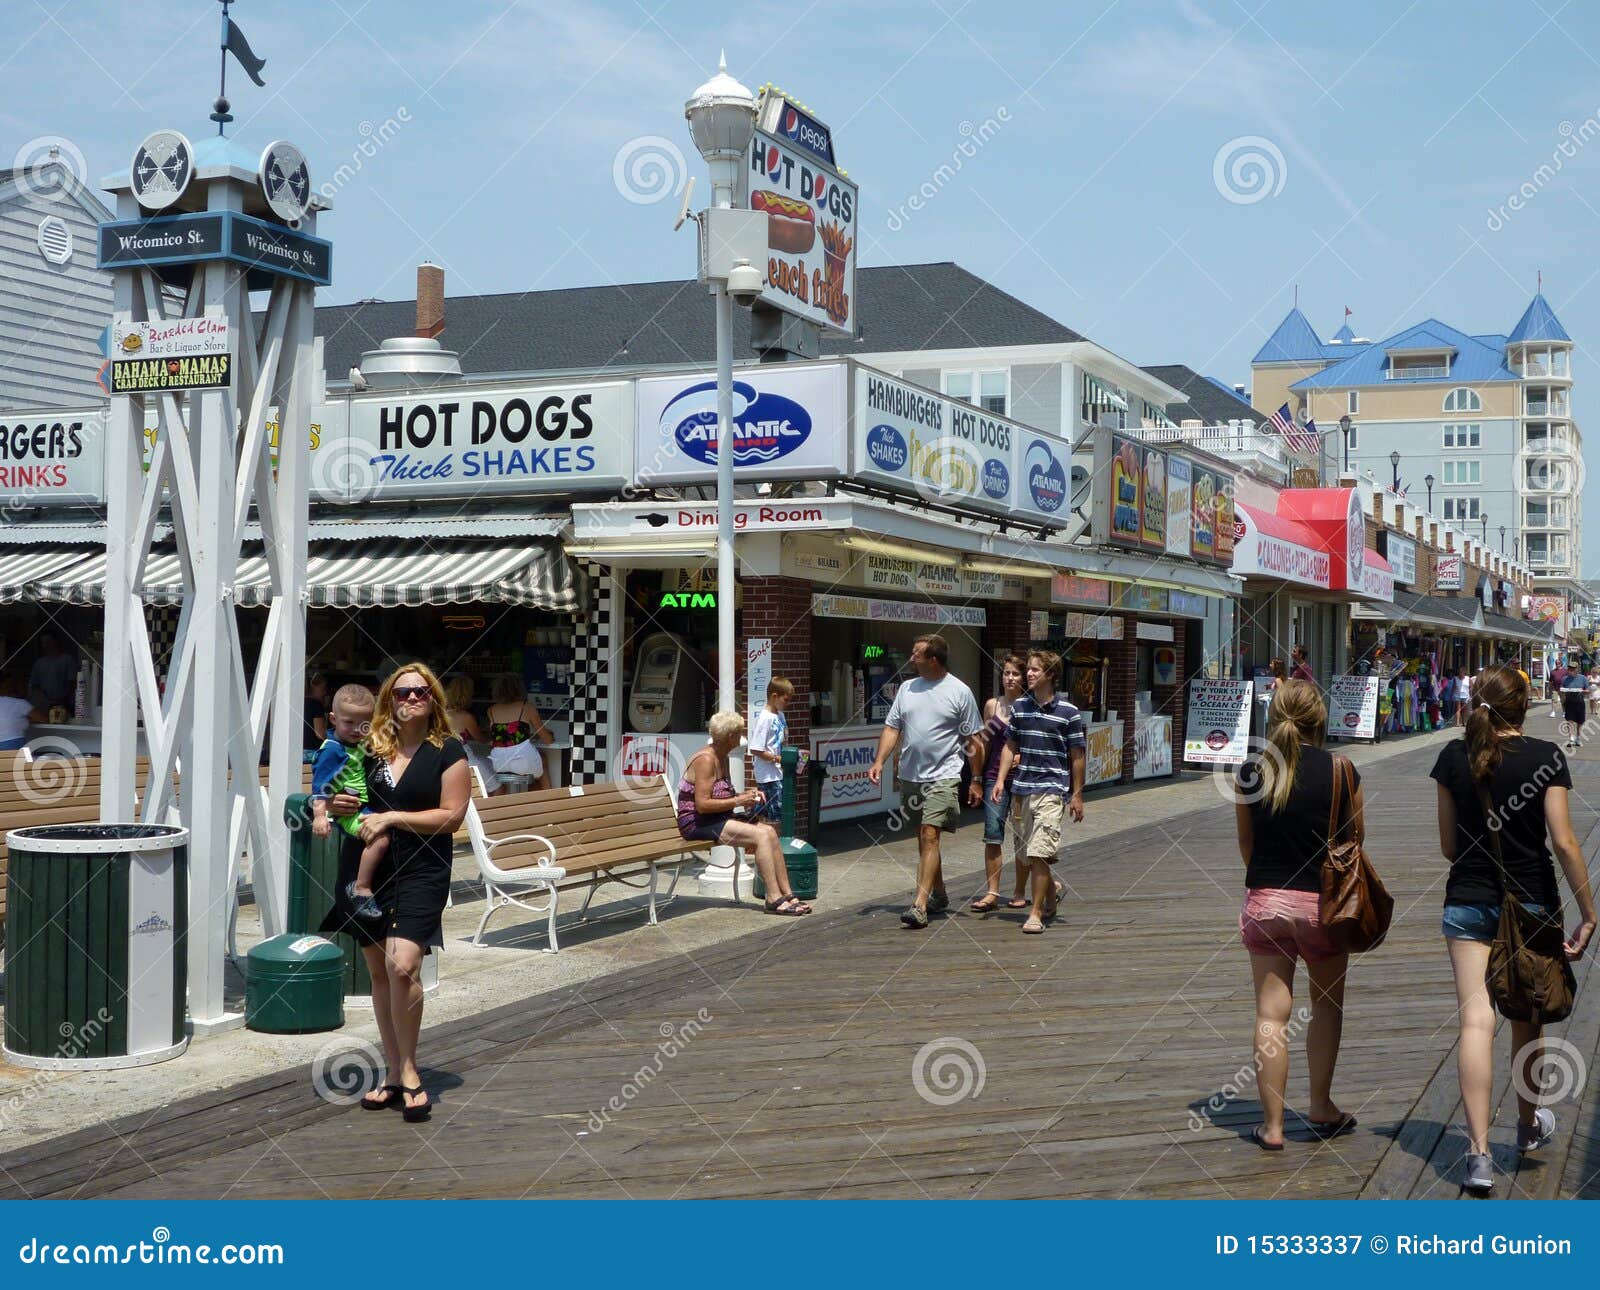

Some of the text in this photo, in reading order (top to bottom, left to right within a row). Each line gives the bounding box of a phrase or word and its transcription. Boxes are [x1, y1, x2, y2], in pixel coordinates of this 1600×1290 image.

[800, 122, 827, 151] pepsi
[118, 229, 205, 250] Wicomico St.
[246, 232, 316, 266] Wicomico St.
[767, 256, 808, 304] ench
[150, 337, 226, 354] Bar & Liquor Store
[114, 356, 228, 380] BAHAMA MAMAS
[116, 373, 223, 389] CRAB DECK & RESTAURANT
[380, 402, 460, 451] HOT
[472, 393, 593, 445] DOGS
[868, 377, 1010, 451] HAMBURGERS HOT DOGS
[684, 420, 801, 442] ATANTIC
[369, 445, 595, 483] Thick SHAKES
[871, 442, 904, 465] SHAKES
[984, 474, 1006, 494] DRINKS
[678, 506, 822, 528] Dinig Room
[868, 556, 912, 573] HAMBURGERS
[918, 564, 959, 583] ATLANTIC
[873, 571, 909, 586] HOT DOGS
[926, 583, 952, 591] STAND
[660, 593, 716, 607] ATM
[749, 641, 770, 663] Soft
[623, 738, 665, 772] ATM
[832, 771, 870, 782] STAND
